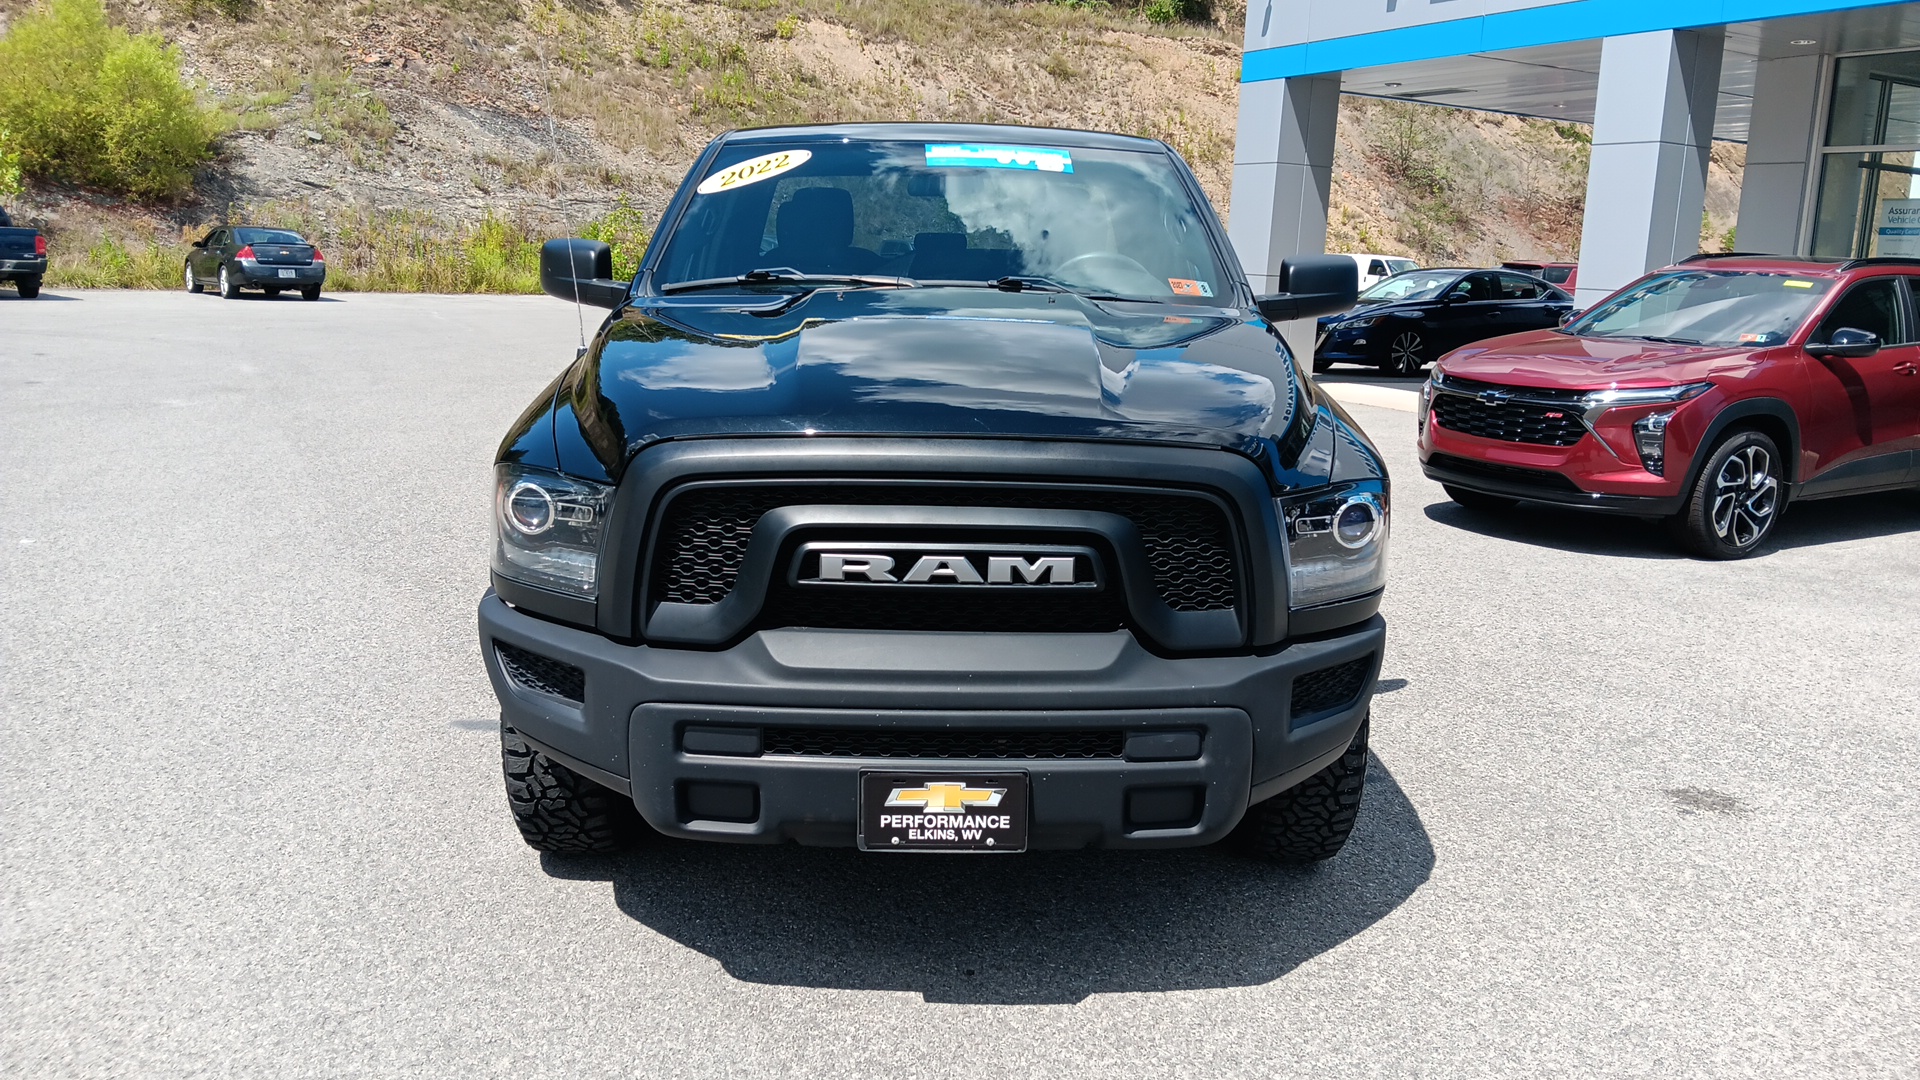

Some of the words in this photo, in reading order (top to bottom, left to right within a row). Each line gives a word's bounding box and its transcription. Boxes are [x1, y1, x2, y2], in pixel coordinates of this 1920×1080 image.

[720, 154, 790, 187] 2022
[1888, 216, 1917, 224] Vehicle
[819, 553, 1075, 583] RAM
[880, 814, 1011, 829] PERFORMANCE
[908, 829, 959, 842] ELKINS,
[961, 829, 983, 840] WV
